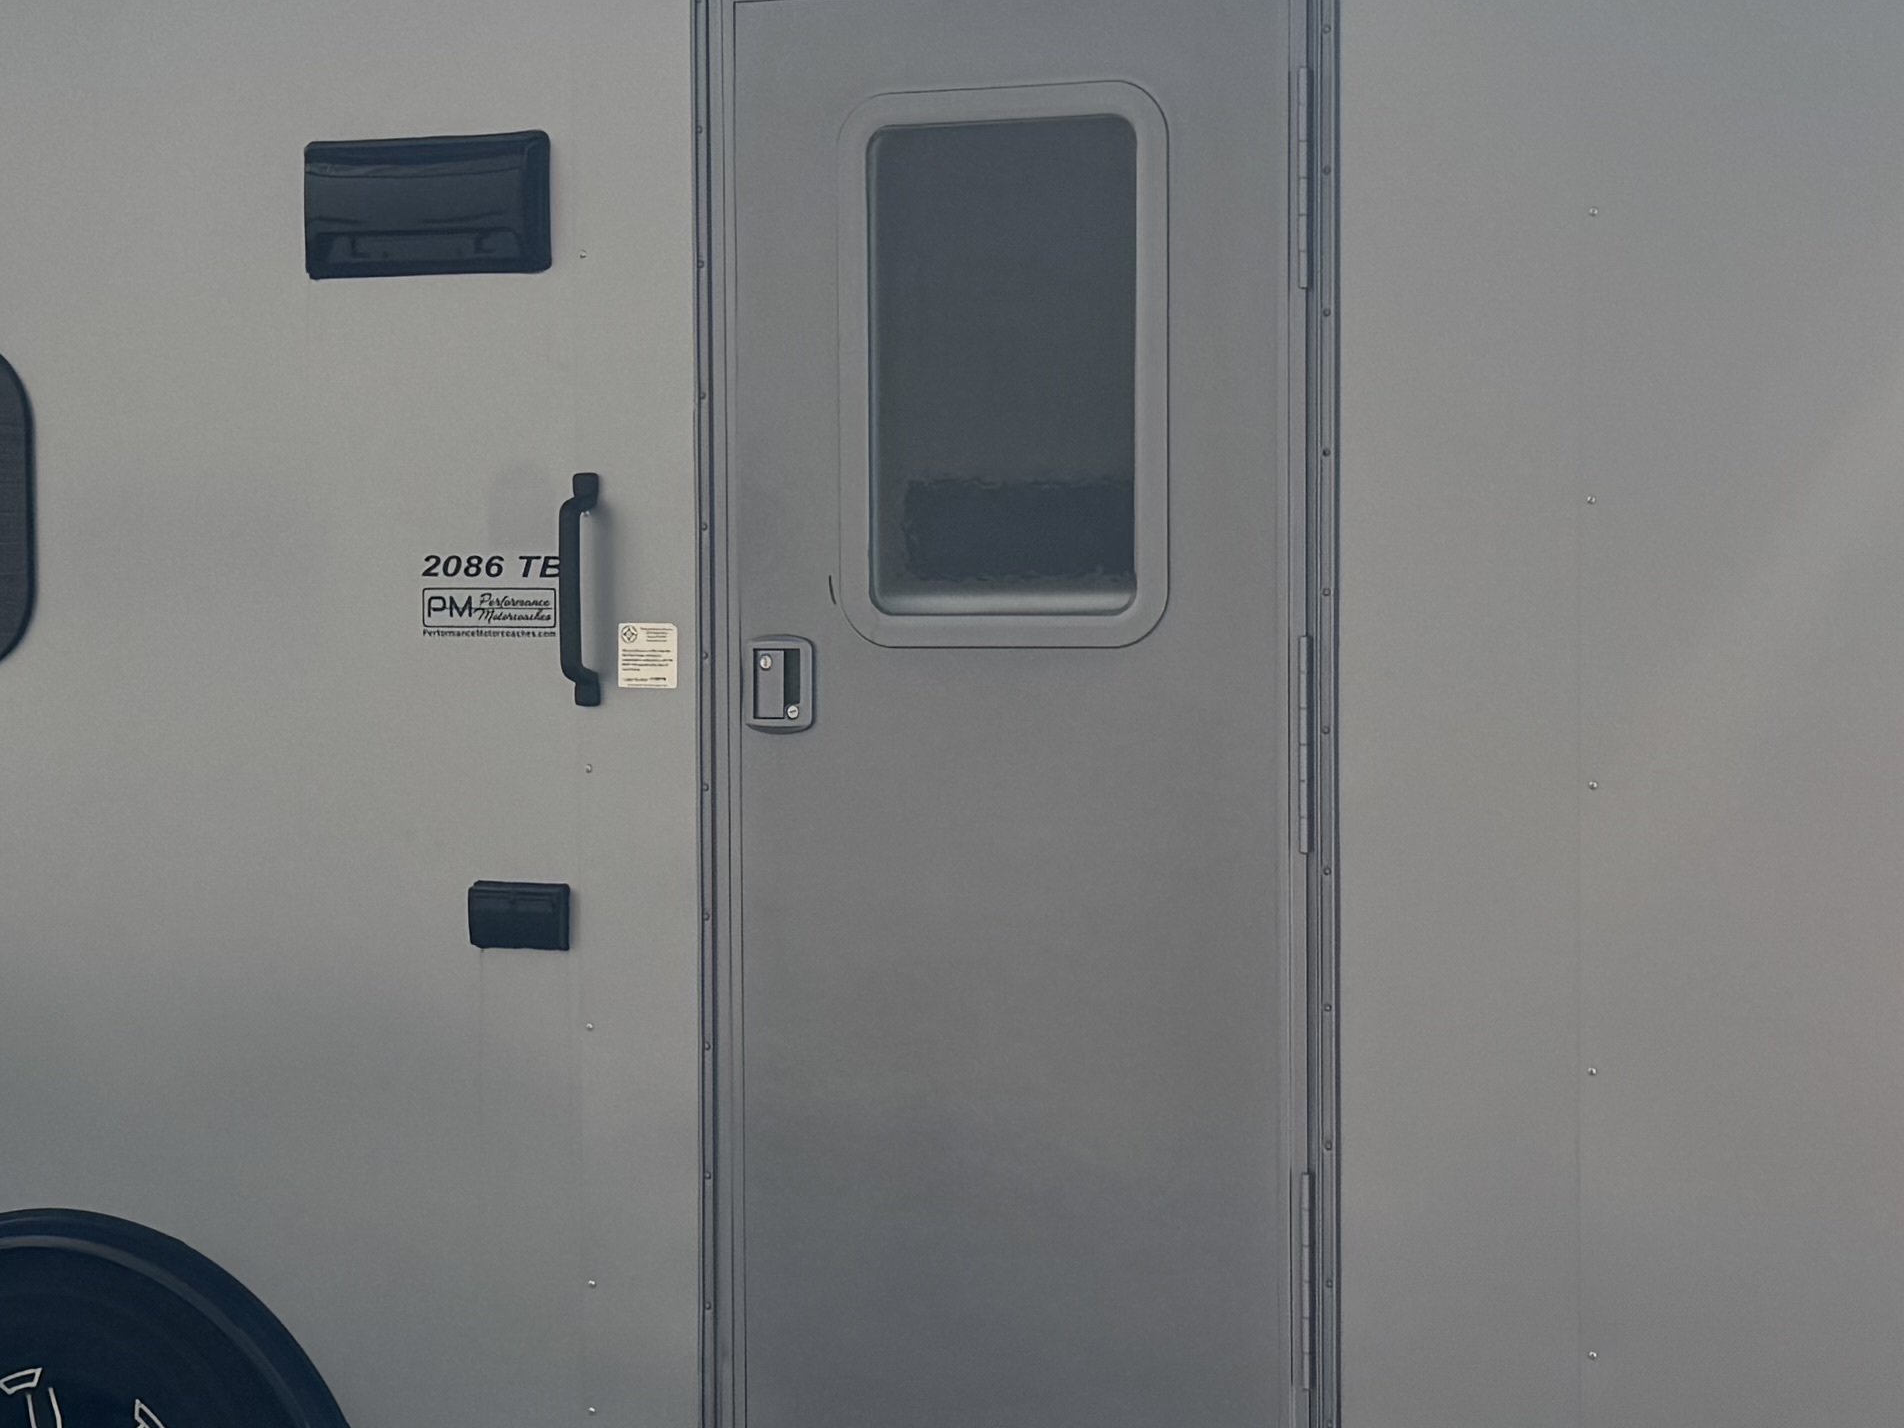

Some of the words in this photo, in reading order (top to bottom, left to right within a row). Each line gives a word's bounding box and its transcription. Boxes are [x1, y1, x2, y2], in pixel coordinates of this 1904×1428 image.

[421, 555, 504, 577] 2086
[518, 556, 560, 577] TB
[427, 595, 473, 618] PM
[480, 593, 550, 608] Performance
[473, 608, 551, 624] Motorcoaches
